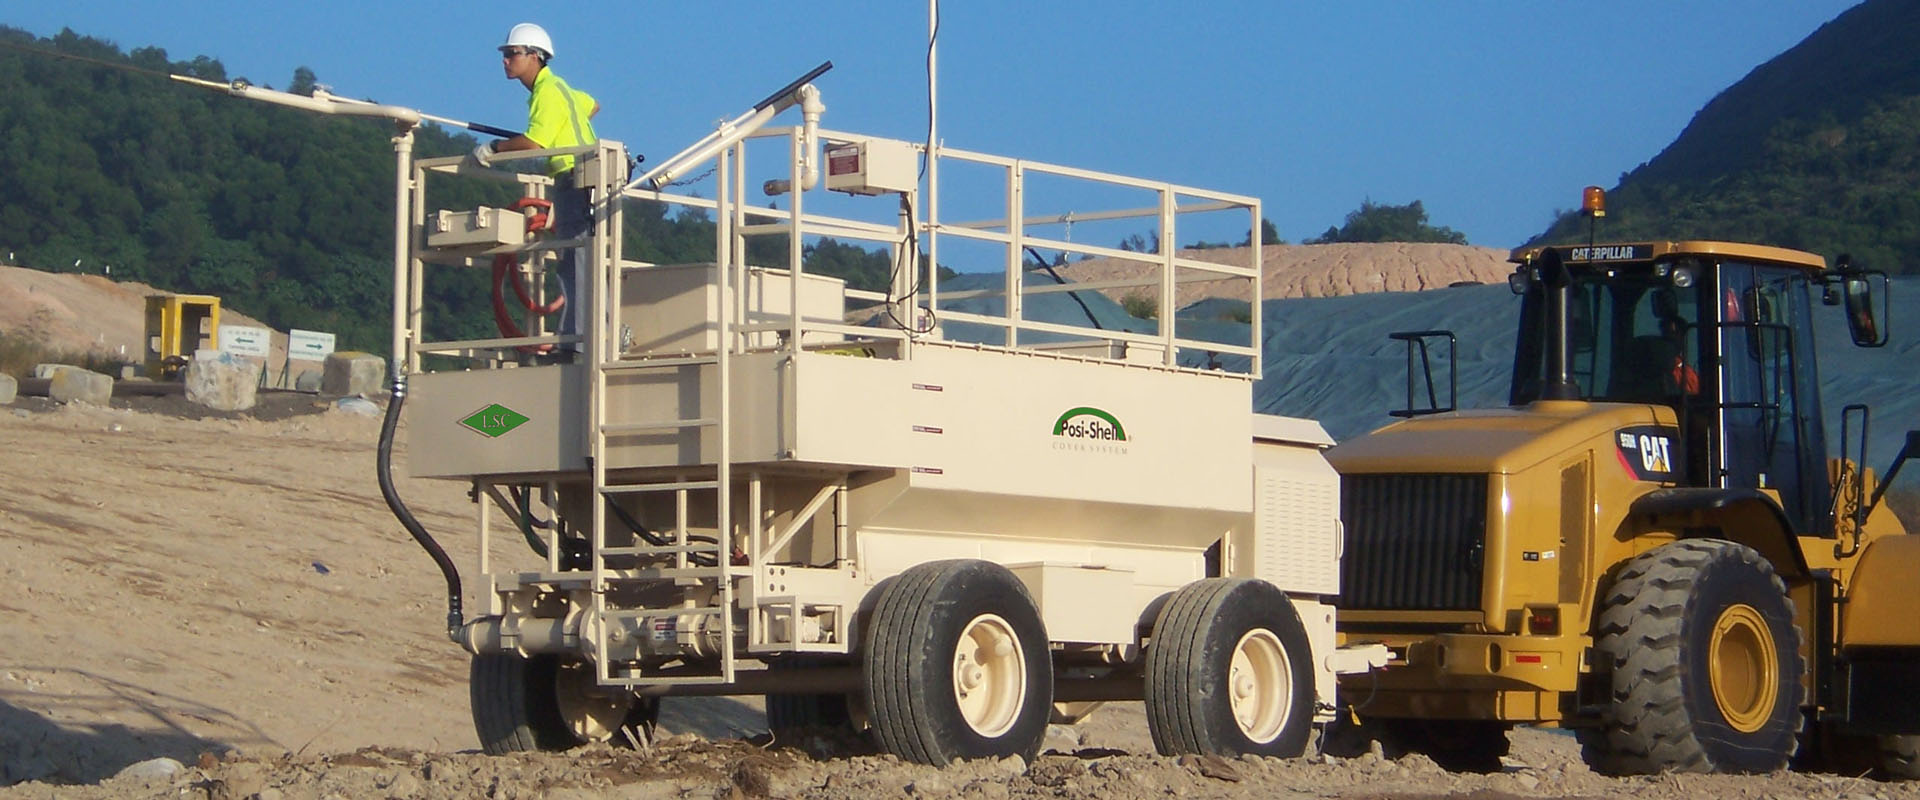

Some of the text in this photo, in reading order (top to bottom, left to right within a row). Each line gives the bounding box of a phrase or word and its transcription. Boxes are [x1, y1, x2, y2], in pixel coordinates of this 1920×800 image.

[1572, 246, 1633, 261] CATERPILLAR
[482, 413, 511, 428] LSC
[1061, 420, 1118, 440] Posi-Shell
[1639, 434, 1671, 473] CAT
